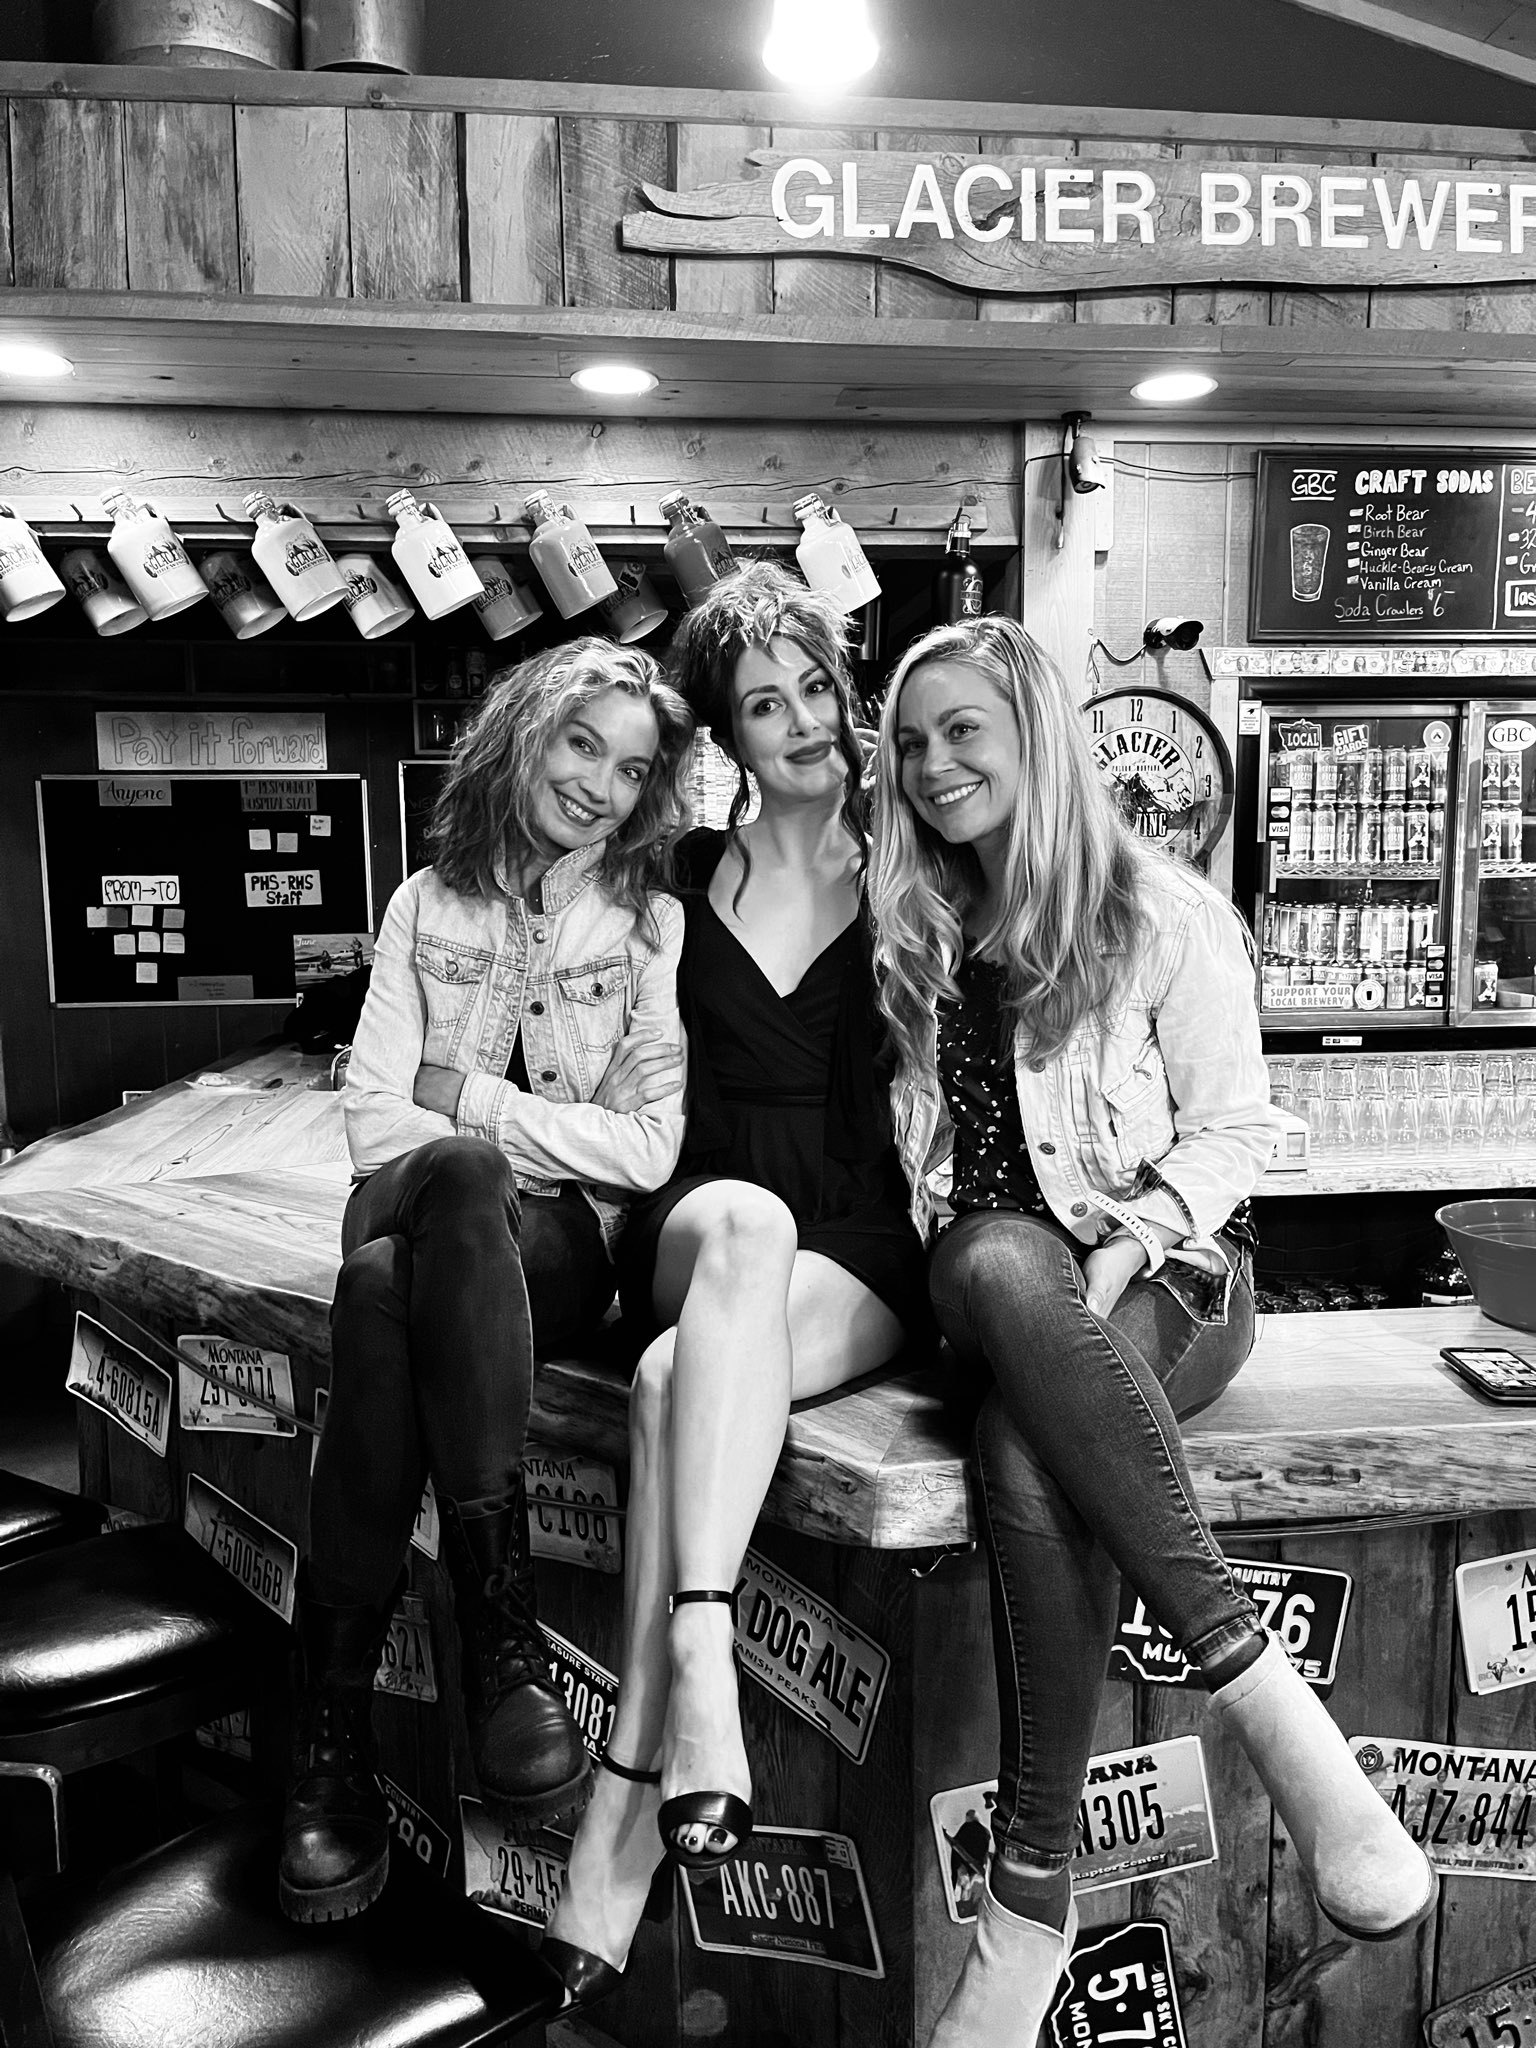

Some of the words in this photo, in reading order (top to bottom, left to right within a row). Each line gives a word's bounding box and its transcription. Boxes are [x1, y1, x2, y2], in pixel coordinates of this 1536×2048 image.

[770, 158, 1157, 245] GLACIER
[1291, 474, 1337, 495] GBC
[1355, 470, 1427, 495] CRAFT
[1436, 470, 1494, 494] SODAS
[1365, 504, 1393, 521] Root
[1396, 504, 1430, 521] Bear
[1363, 524, 1395, 539] Birch
[1397, 524, 1428, 539] Bear
[1361, 542, 1399, 561] Ginger
[1400, 542, 1430, 558] Bear
[1438, 559, 1473, 574] Cream
[1361, 576, 1401, 591] Vanilla
[1403, 576, 1442, 589] Cream
[1334, 594, 1371, 618] Soda
[1375, 593, 1424, 616] Crawlers
[1130, 698, 1143, 722] 12
[1093, 710, 1104, 734] 11
[1172, 710, 1177, 734] 1
[189, 722, 222, 766] it
[228, 716, 325, 766] forward
[1288, 733, 1320, 747] LOCAL
[1334, 724, 1365, 747] GIFT
[1492, 726, 1532, 743] GBC
[1196, 736, 1203, 759] 2
[1336, 738, 1368, 756] CARDS
[103, 785, 166, 807] Anyone
[1205, 774, 1212, 798] 3
[1194, 816, 1201, 841] 4
[1271, 825, 1289, 833] VISA
[155, 881, 178, 901] TO
[266, 891, 303, 906] Staff
[1270, 986, 1319, 998] SUPPORT
[1323, 986, 1351, 997] YOUR
[1270, 997, 1298, 1007] LOCAL
[1301, 996, 1345, 1007] BREWERY
[207, 1345, 264, 1366] MONTANA
[520, 1457, 577, 1482] NTANA
[1234, 1567, 1292, 1587] OUNTRY
[745, 1556, 834, 1631] MONTANA
[746, 1588, 812, 1677] DOG
[808, 1640, 872, 1728] ALE
[583, 1666, 614, 1693] STATE
[733, 1640, 774, 1676] ANISH
[777, 1672, 818, 1710] PEAKS
[1072, 1863, 1120, 1882] Raptor
[1121, 1852, 1167, 1870] Center
[1156, 2000, 1174, 2031] SKY
